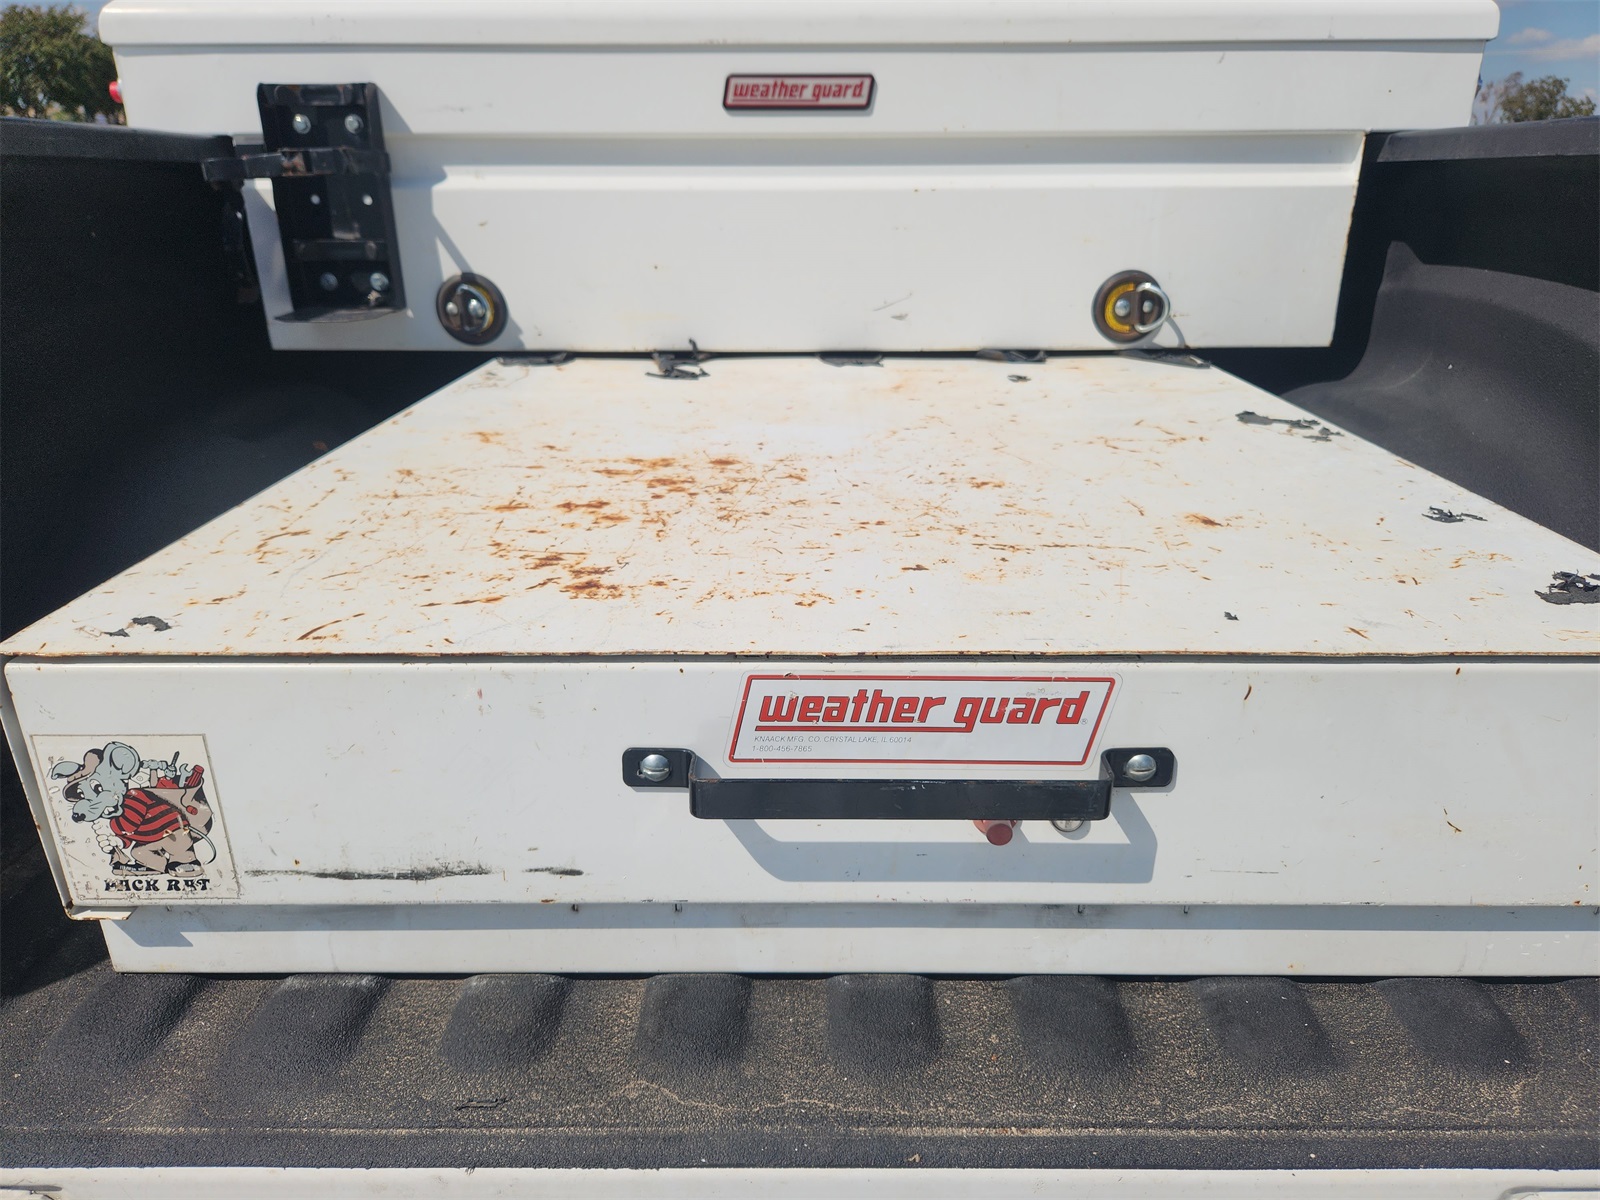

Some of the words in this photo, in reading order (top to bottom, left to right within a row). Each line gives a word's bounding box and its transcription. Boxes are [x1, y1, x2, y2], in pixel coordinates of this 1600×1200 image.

[733, 80, 808, 98] weather
[812, 80, 864, 102] guard
[759, 689, 946, 723] weather
[754, 735, 786, 743] KNAACK
[808, 735, 822, 743] CO.
[858, 736, 879, 744] LAKE,
[752, 745, 813, 753] 1-800-456-7865
